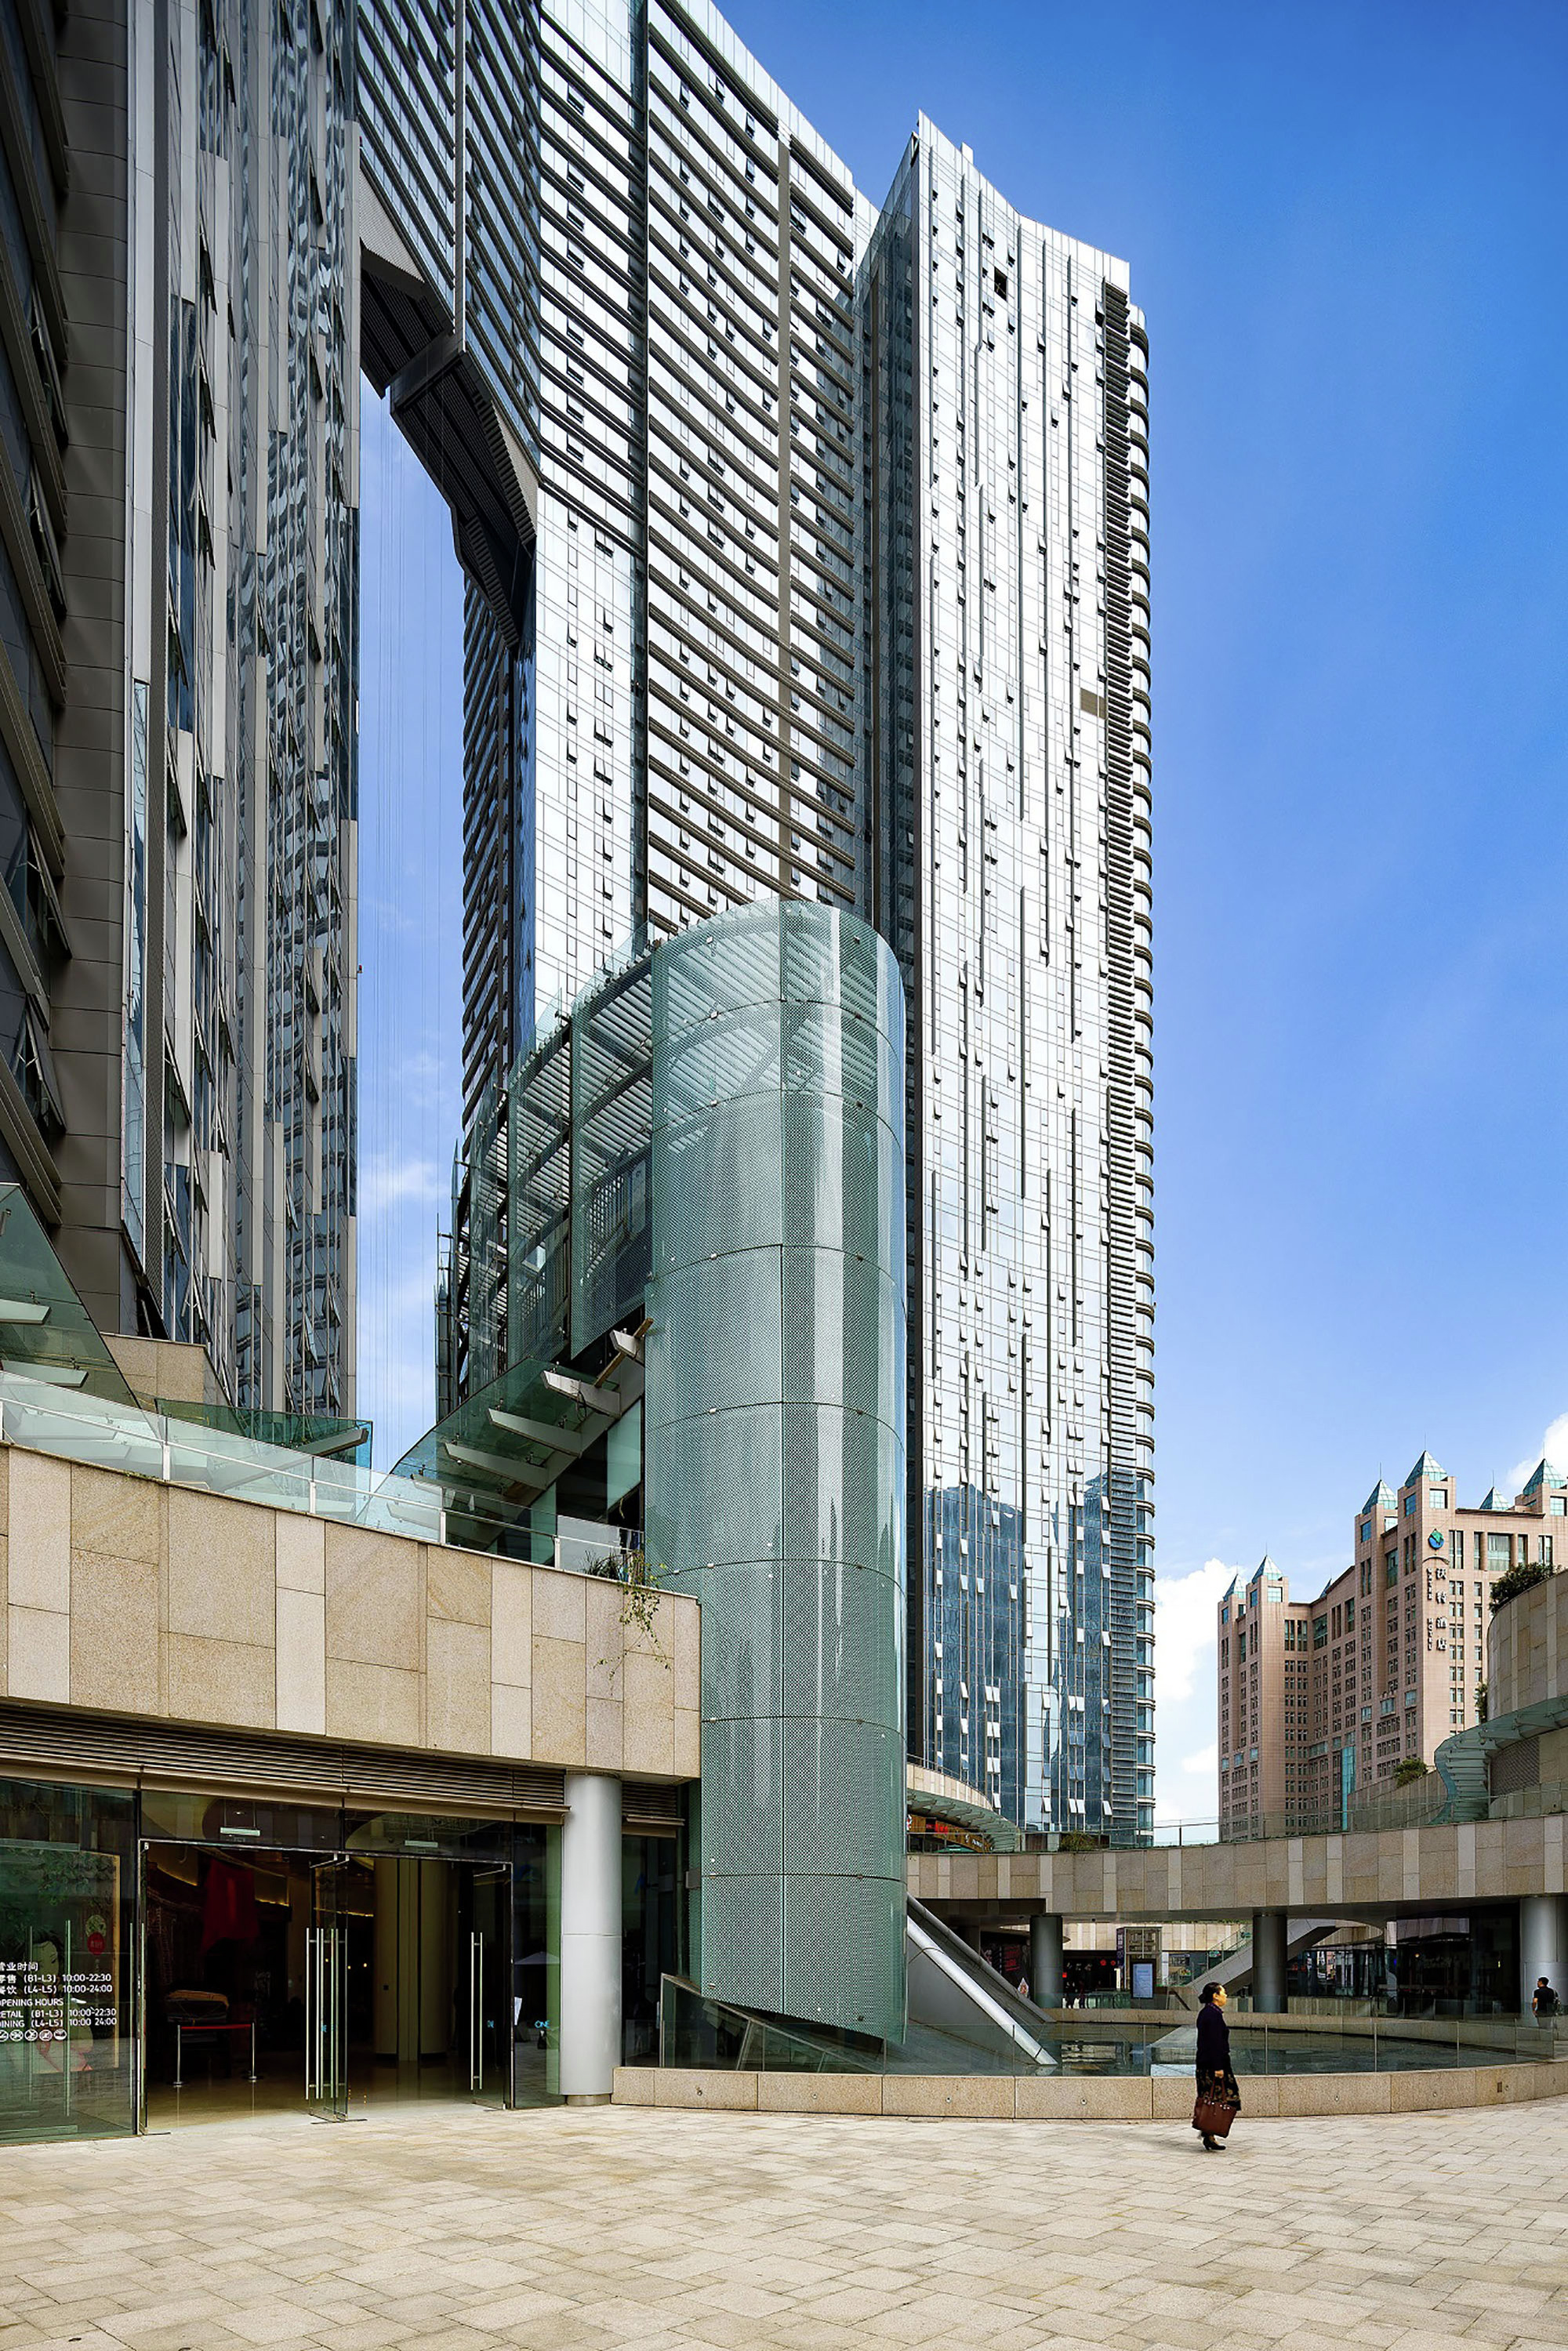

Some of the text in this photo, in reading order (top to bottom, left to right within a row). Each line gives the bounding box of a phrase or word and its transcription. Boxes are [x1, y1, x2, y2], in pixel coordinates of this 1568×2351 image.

[62, 1974, 111, 1983] 10:00-22:30
[24, 1985, 57, 1994] (L4-L5)
[63, 1984, 113, 1994] 10:00-24:00
[0, 2010, 24, 2019] ETAIL
[69, 2008, 117, 2016] 10:00-22:30
[0, 2019, 25, 2028] INING
[31, 2019, 64, 2028] (L4-L5)
[534, 2019, 551, 2029] ONE
